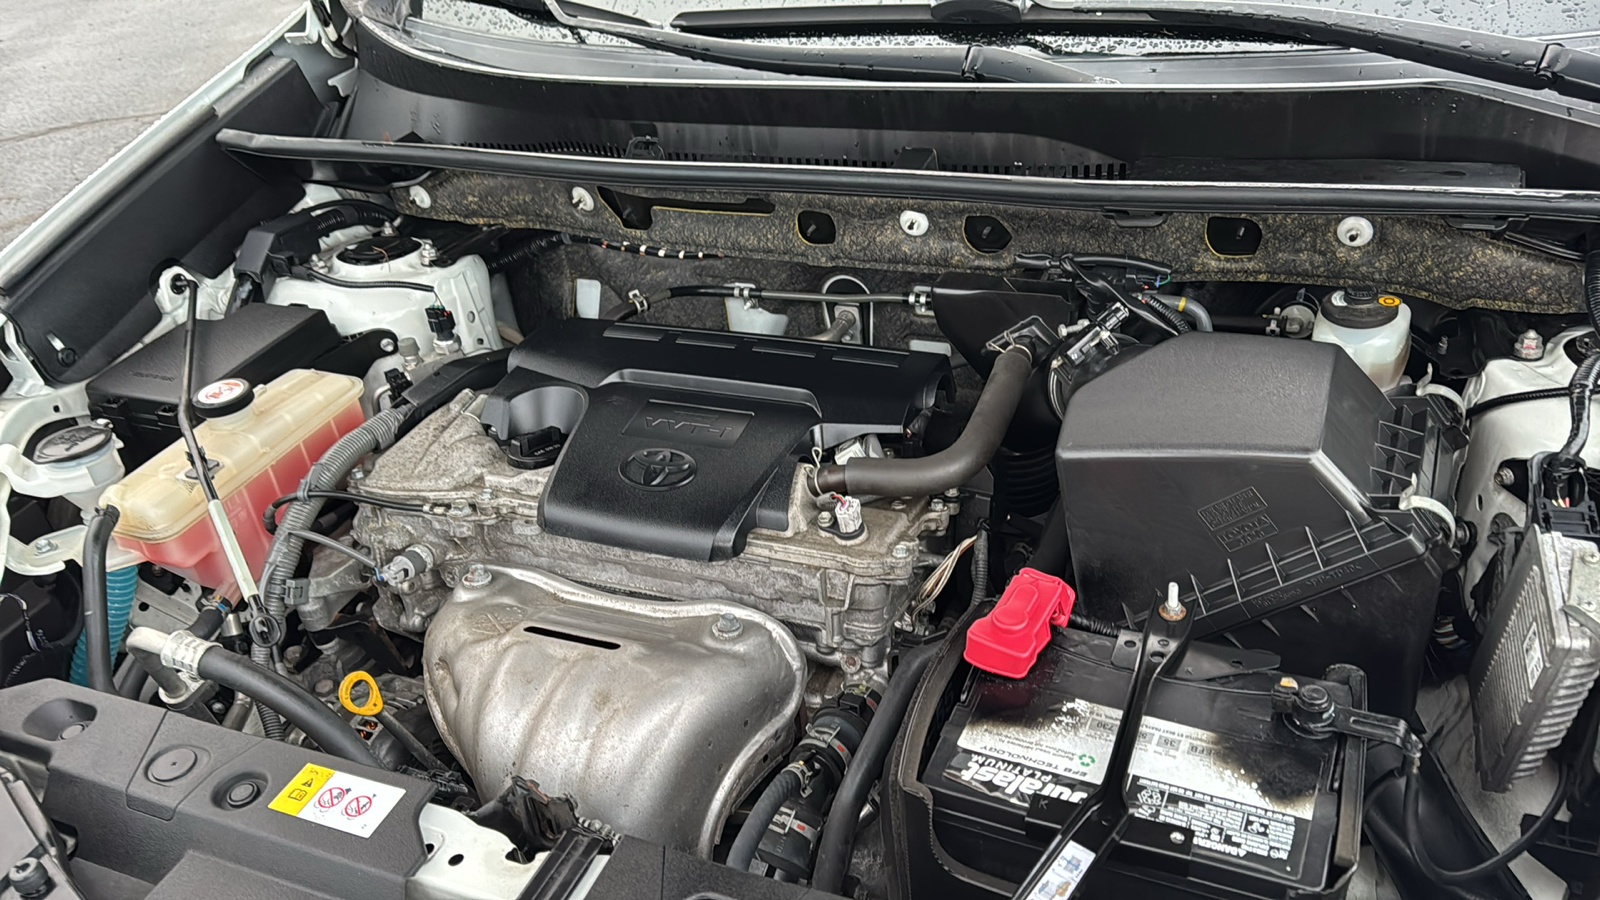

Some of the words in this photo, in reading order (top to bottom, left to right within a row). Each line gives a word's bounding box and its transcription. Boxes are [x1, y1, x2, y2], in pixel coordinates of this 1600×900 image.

[1096, 721, 1114, 731] 730
[1162, 738, 1176, 747] 35
[978, 744, 1059, 770] TECHNOLOGY
[1063, 766, 1087, 777] EFB
